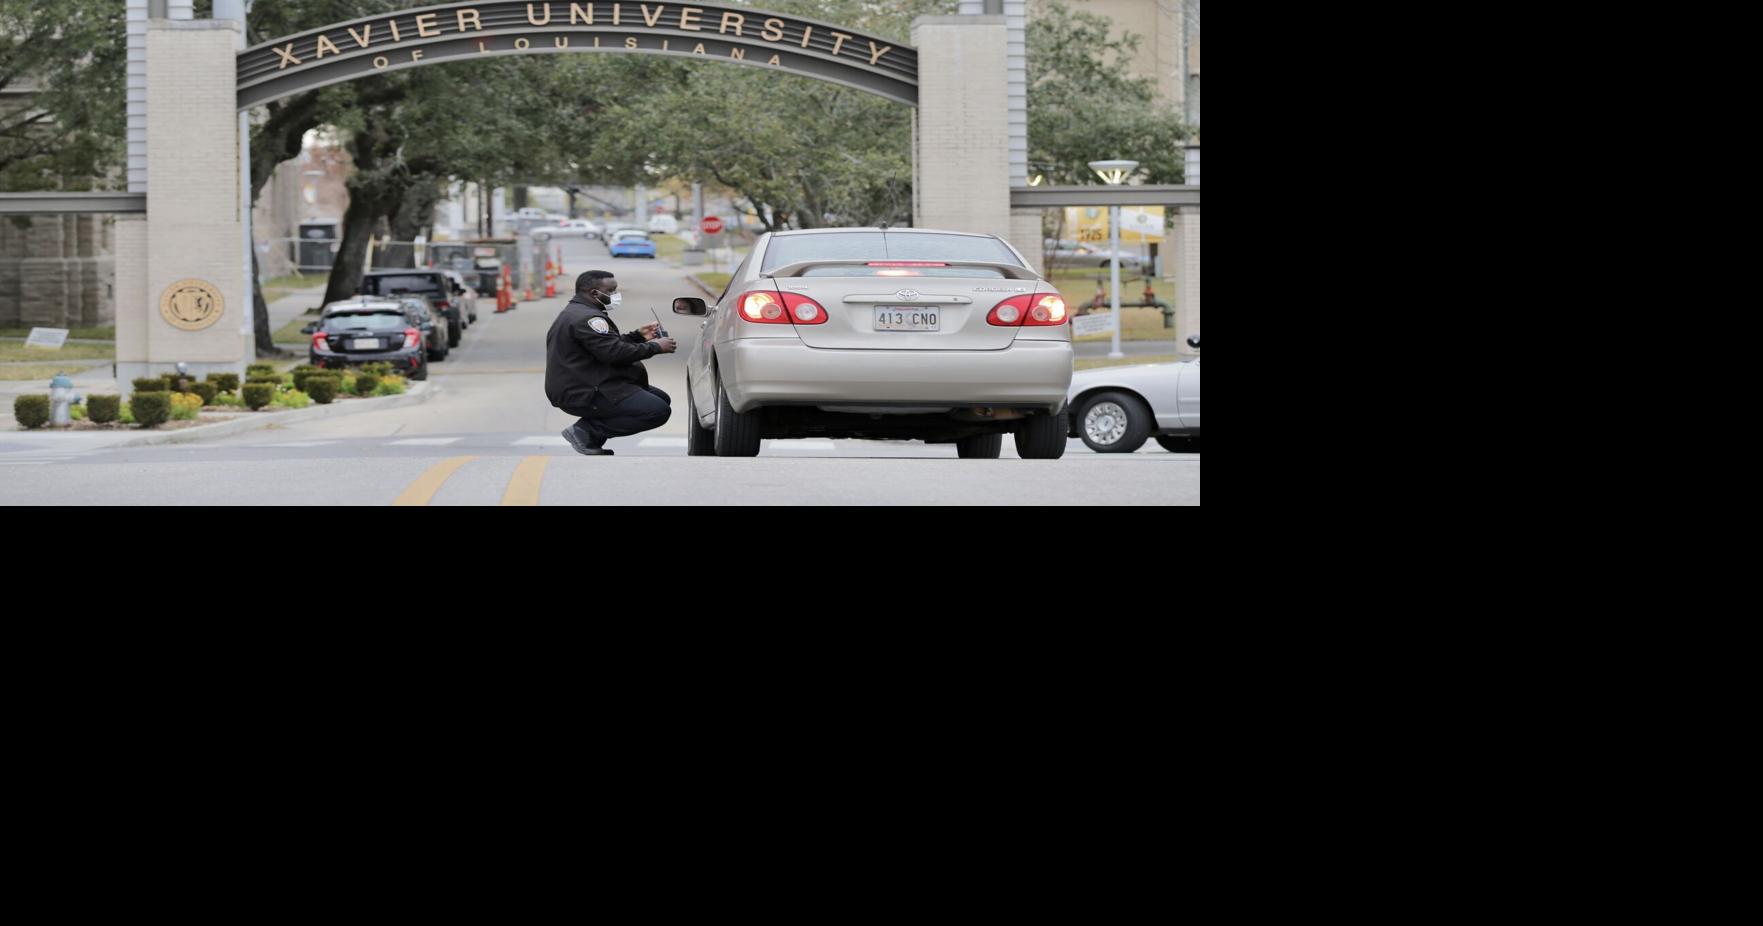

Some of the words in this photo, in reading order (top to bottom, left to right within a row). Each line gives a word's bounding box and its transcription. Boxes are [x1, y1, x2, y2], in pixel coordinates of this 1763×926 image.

[272, 8, 483, 69] XAVIER
[526, 2, 892, 66] UNIVERSITY
[373, 50, 424, 69] OF
[478, 35, 781, 67] LOUISIANA
[878, 312, 903, 325] 413
